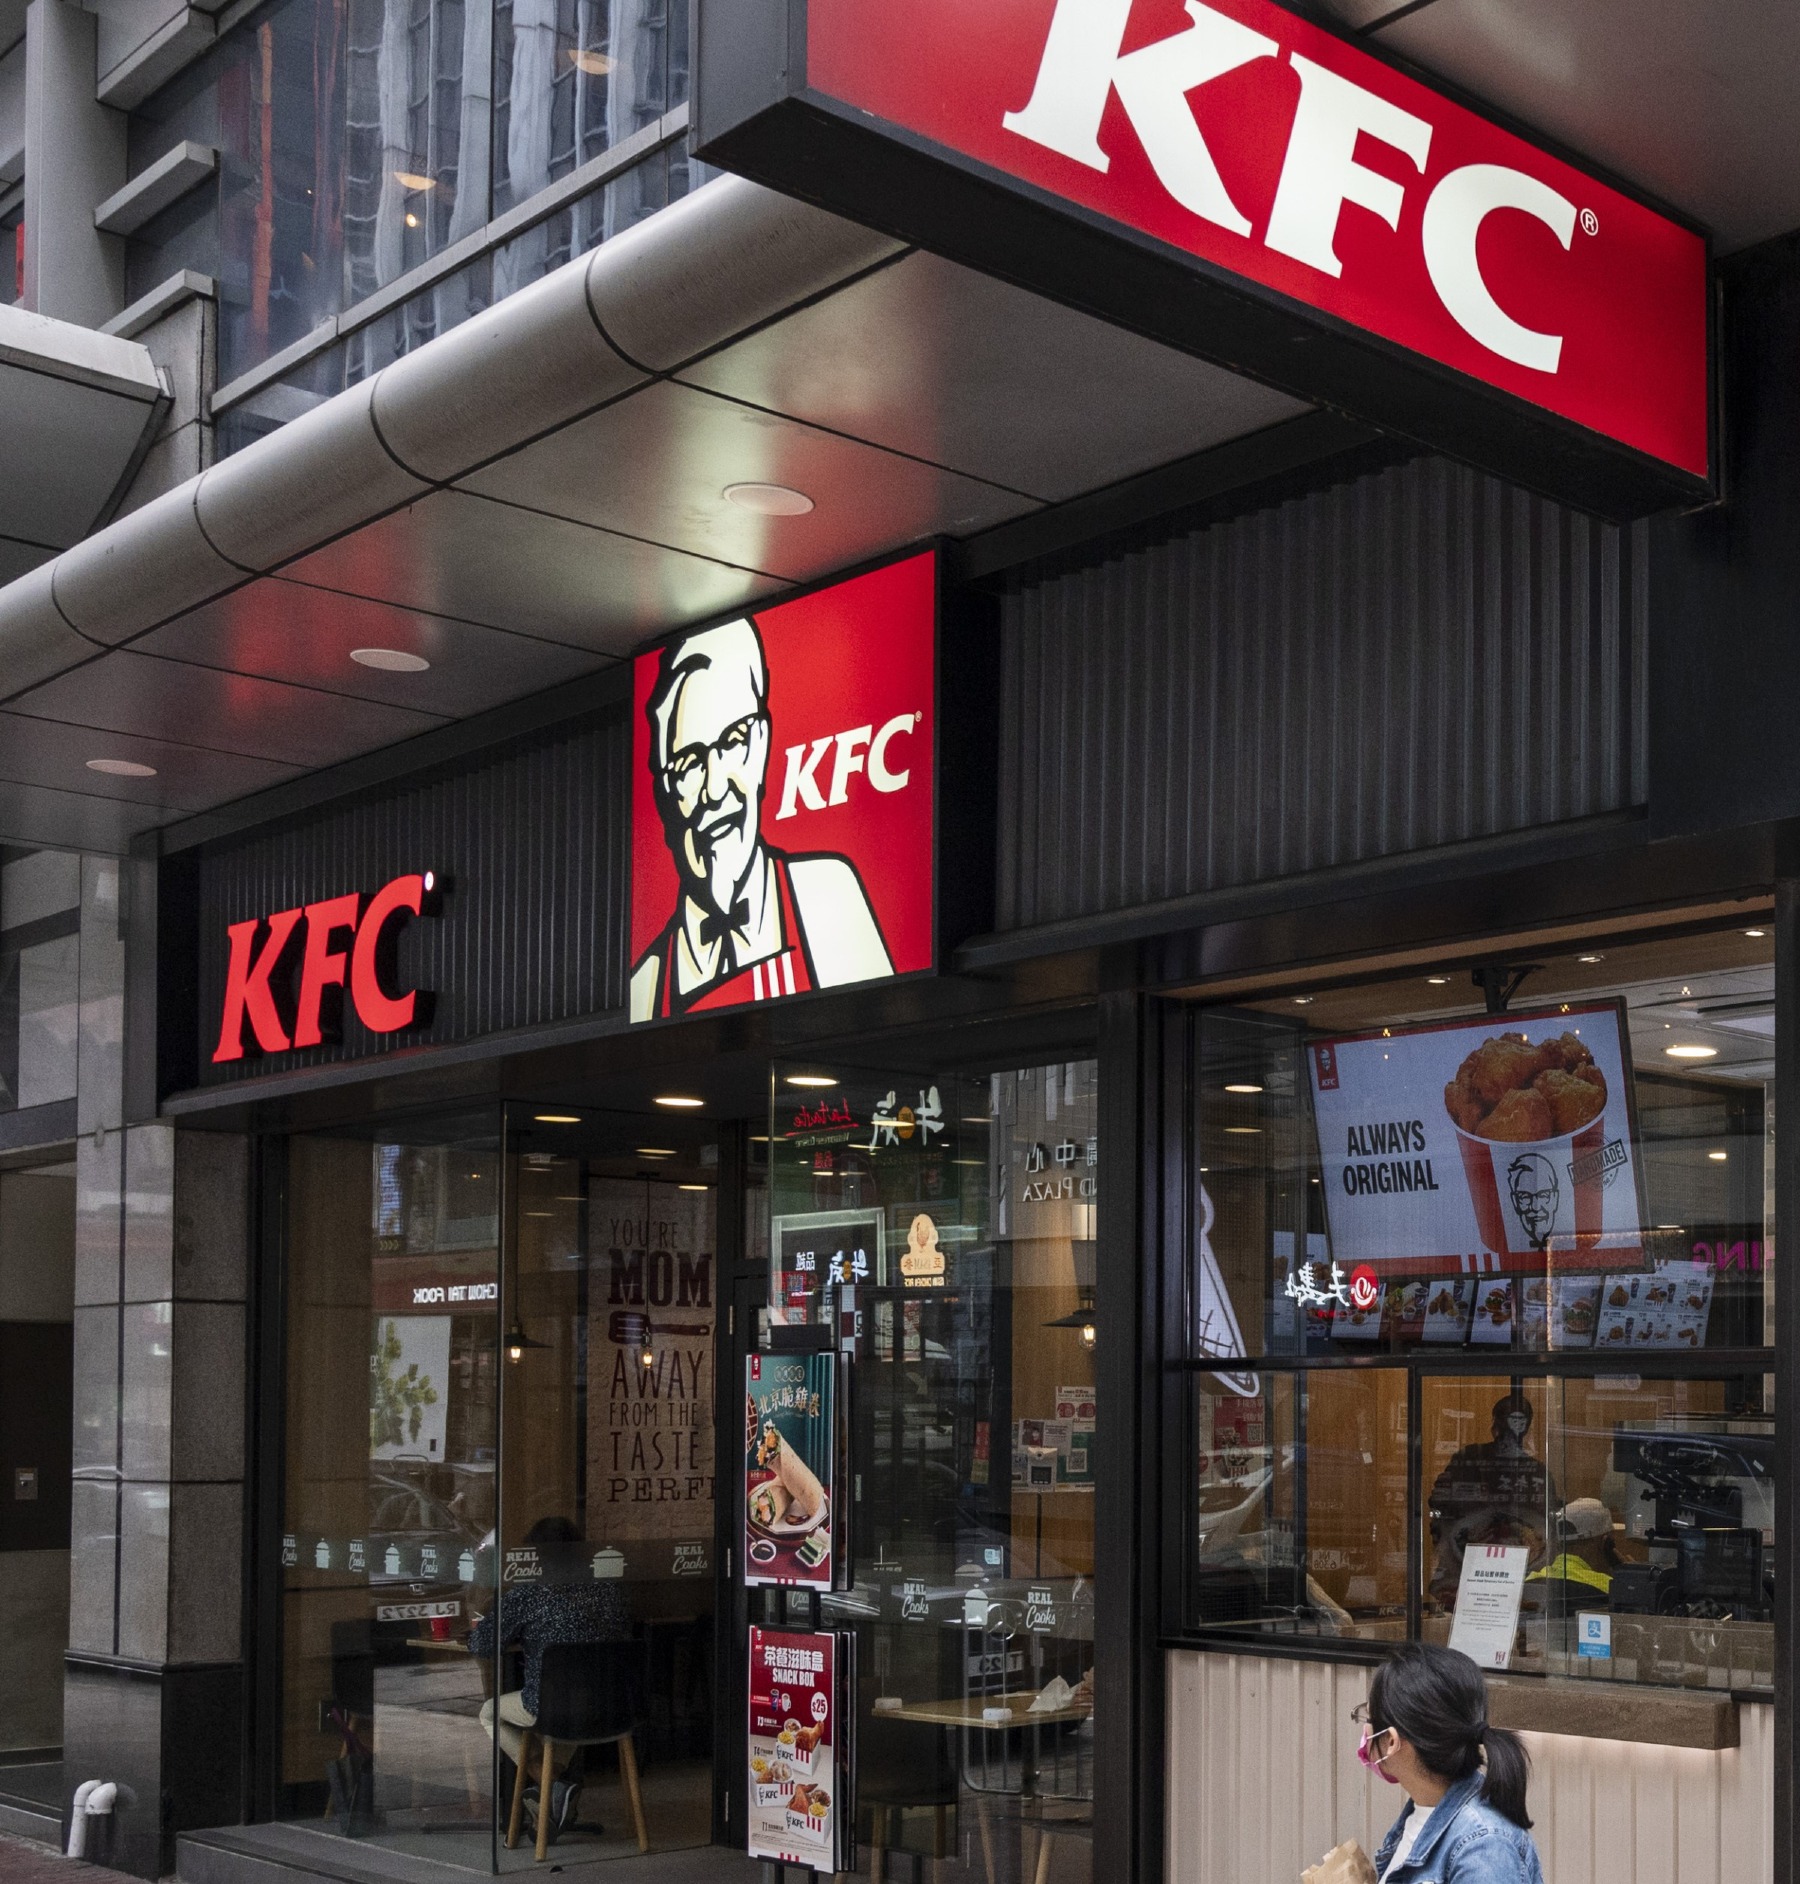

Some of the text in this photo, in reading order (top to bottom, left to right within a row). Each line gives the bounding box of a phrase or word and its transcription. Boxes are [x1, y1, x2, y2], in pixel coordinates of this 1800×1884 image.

[1001, 0, 1578, 375] KFC
[775, 713, 914, 821] KFC
[212, 875, 424, 1063] KFC
[1347, 1119, 1426, 1158] ALWAYS
[1343, 1159, 1439, 1197] ORIGINAL
[609, 1218, 679, 1250] YOU'RE
[610, 1349, 703, 1400] AWAY
[759, 1384, 821, 1418] 北京脆雞卷
[609, 1402, 699, 1428] FROM THE
[610, 1430, 700, 1472] TASTE
[421, 1549, 437, 1558] REAL
[505, 1551, 540, 1563] REAL
[674, 1546, 704, 1556] REAL
[503, 1563, 543, 1581] Cooks
[672, 1556, 708, 1576] Cooks
[903, 1584, 927, 1597] REAL
[1027, 1592, 1053, 1605] REAL
[902, 1596, 930, 1618] Cooks
[1025, 1605, 1056, 1627] Cooks
[764, 1645, 824, 1672] 茶餐滋味盒
[772, 1667, 815, 1688] SNACK BOX
[812, 1699, 826, 1715] $25
[781, 1750, 794, 1762] KFC
[765, 1791, 778, 1799] KFC
[791, 1817, 805, 1830] KFC
